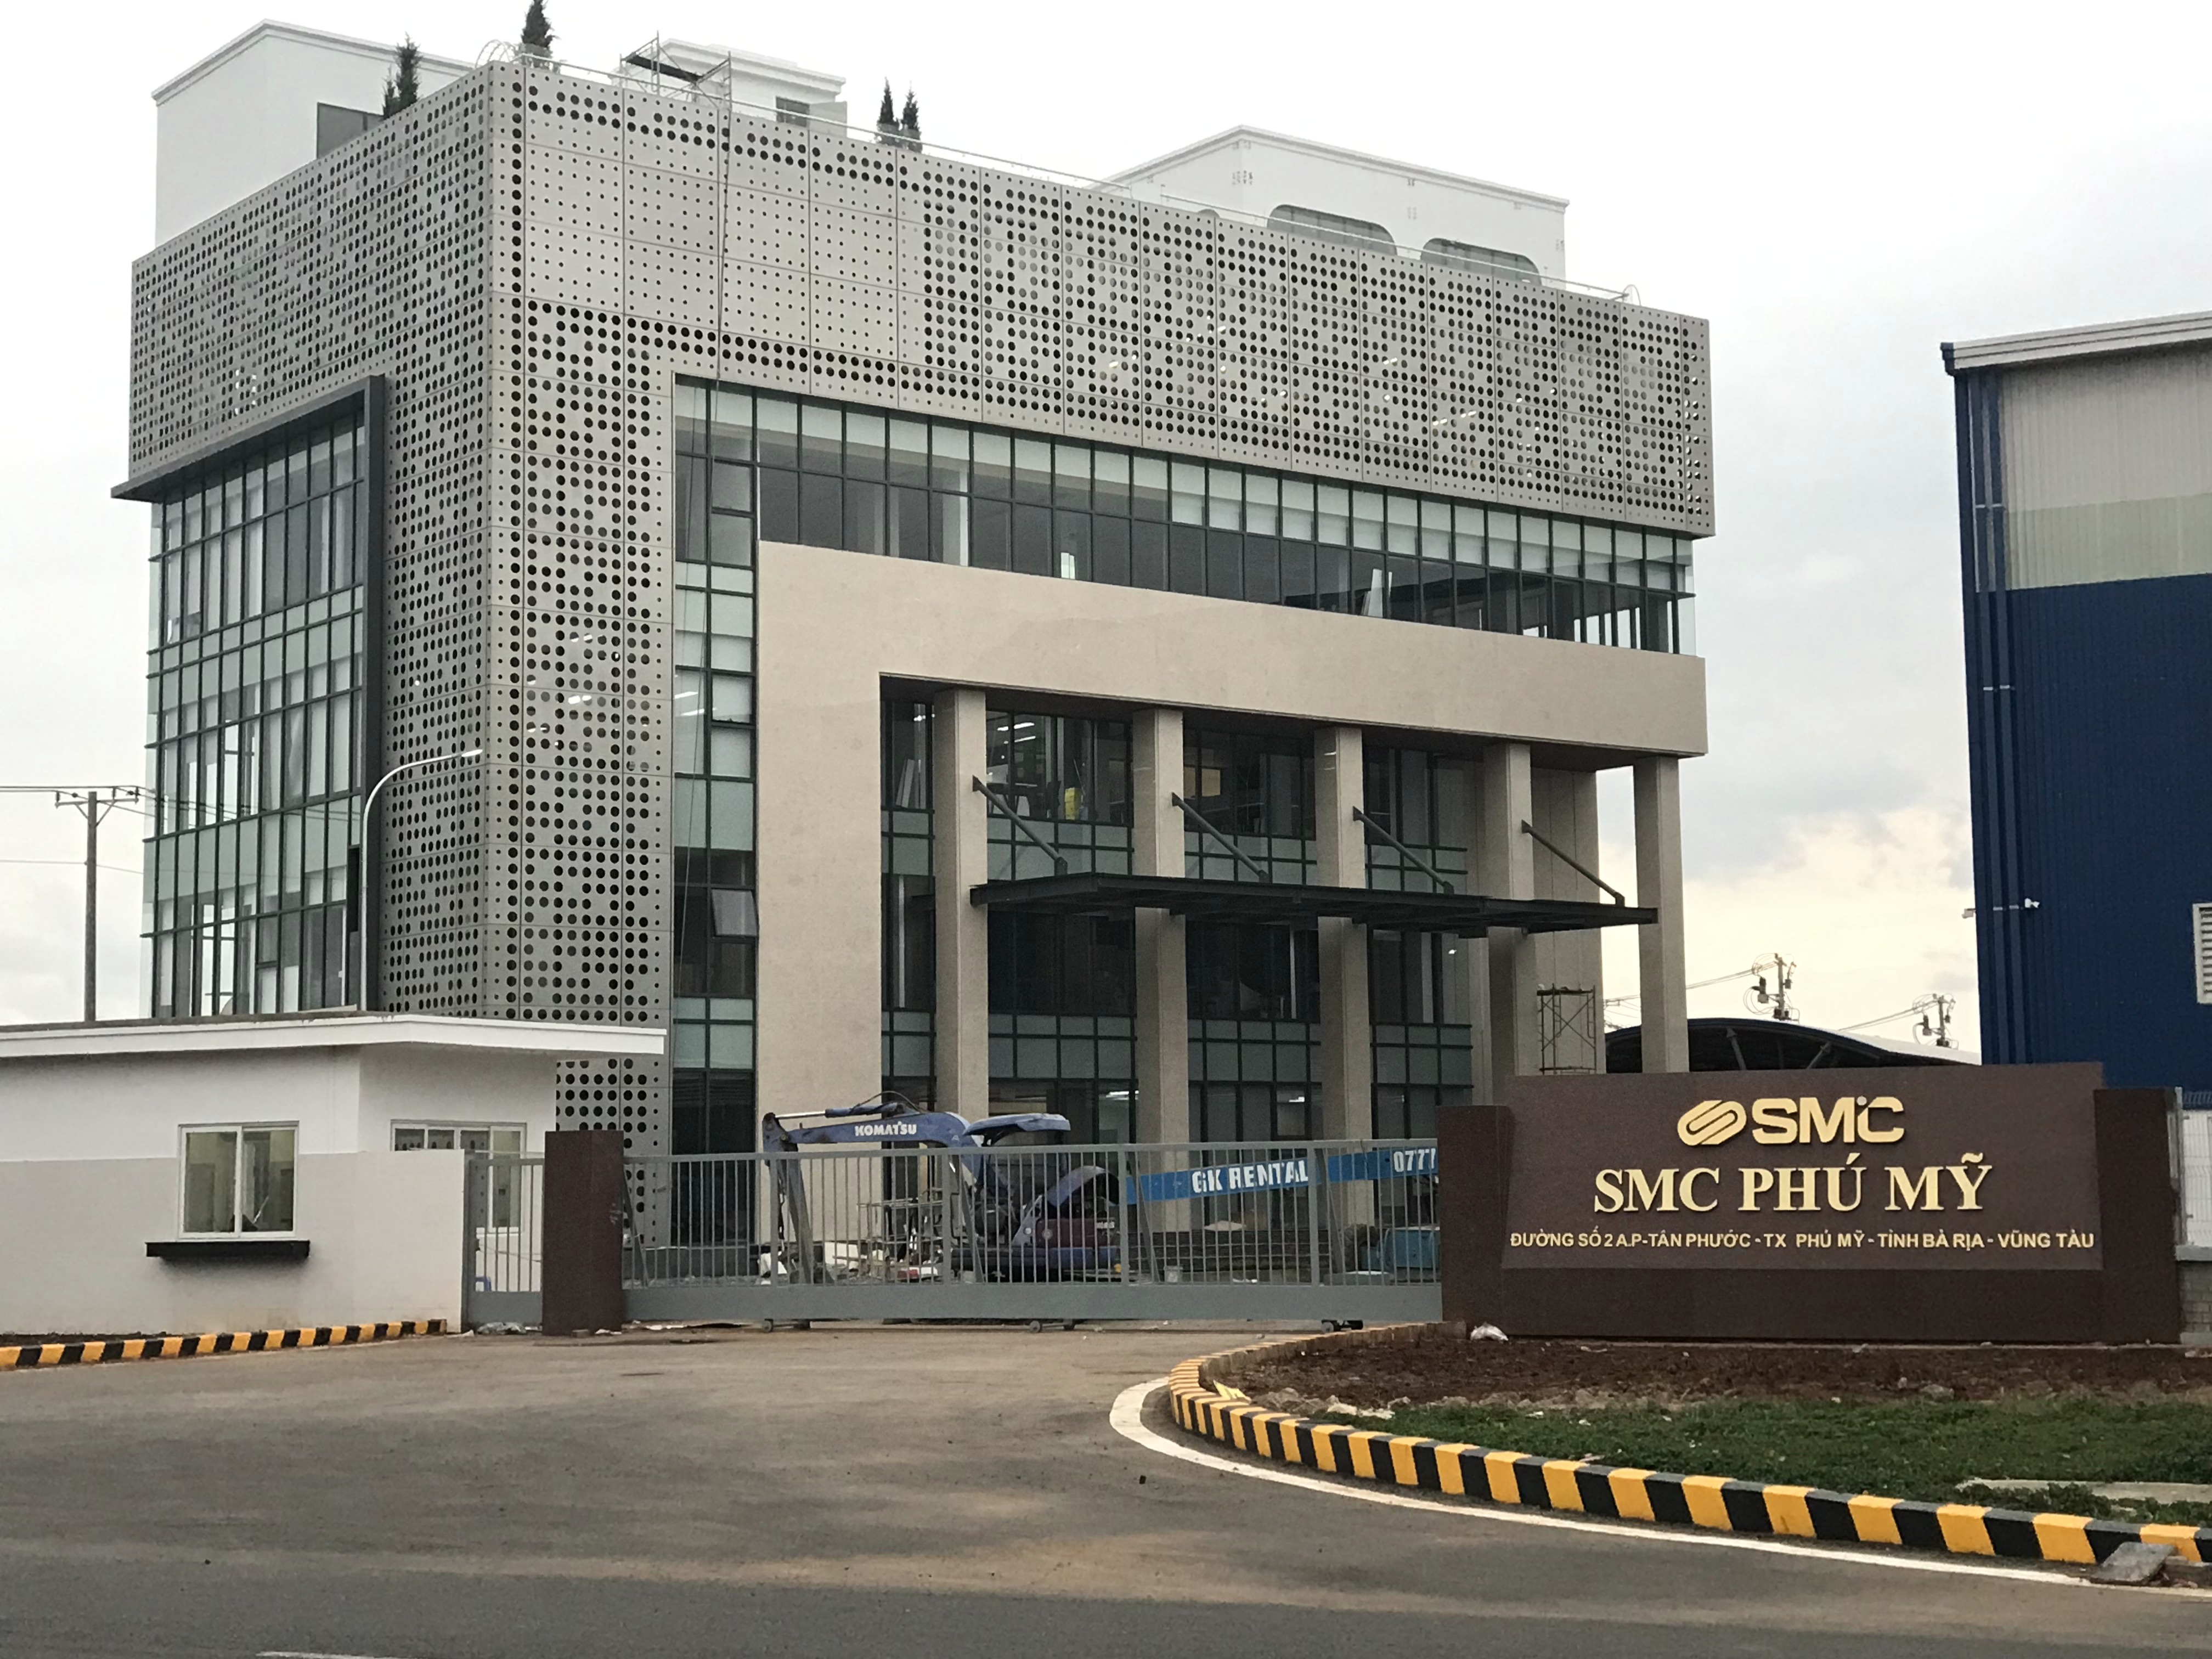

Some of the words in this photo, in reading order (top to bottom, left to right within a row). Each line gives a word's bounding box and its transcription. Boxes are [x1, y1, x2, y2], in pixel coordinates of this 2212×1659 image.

[854, 1122, 917, 1137] KOMATSU
[1752, 1096, 1904, 1144] SMC
[1192, 1169, 1223, 1193] GK
[1228, 1160, 1308, 1190] RENTAL
[1594, 1167, 1719, 1212] SMC
[1738, 1153, 1866, 1211] PHÚ
[1884, 1153, 1992, 1210] MỸ
[1510, 1228, 1574, 1247] ĐƯỜNG
[1578, 1225, 1602, 1247] SỐ
[1604, 1233, 1613, 1247] 2
[1686, 1229, 1751, 1248] PHƯỚC
[1764, 1233, 1787, 1248] TX
[1796, 1229, 1832, 1248] PHÚ
[1837, 1229, 1865, 1248] MỸ
[1922, 1229, 1950, 1248] BÀ
[1953, 1233, 1985, 1251] RỊA
[1997, 1229, 2051, 1248] VŨNG
[2056, 1229, 2094, 1248] TÀU
